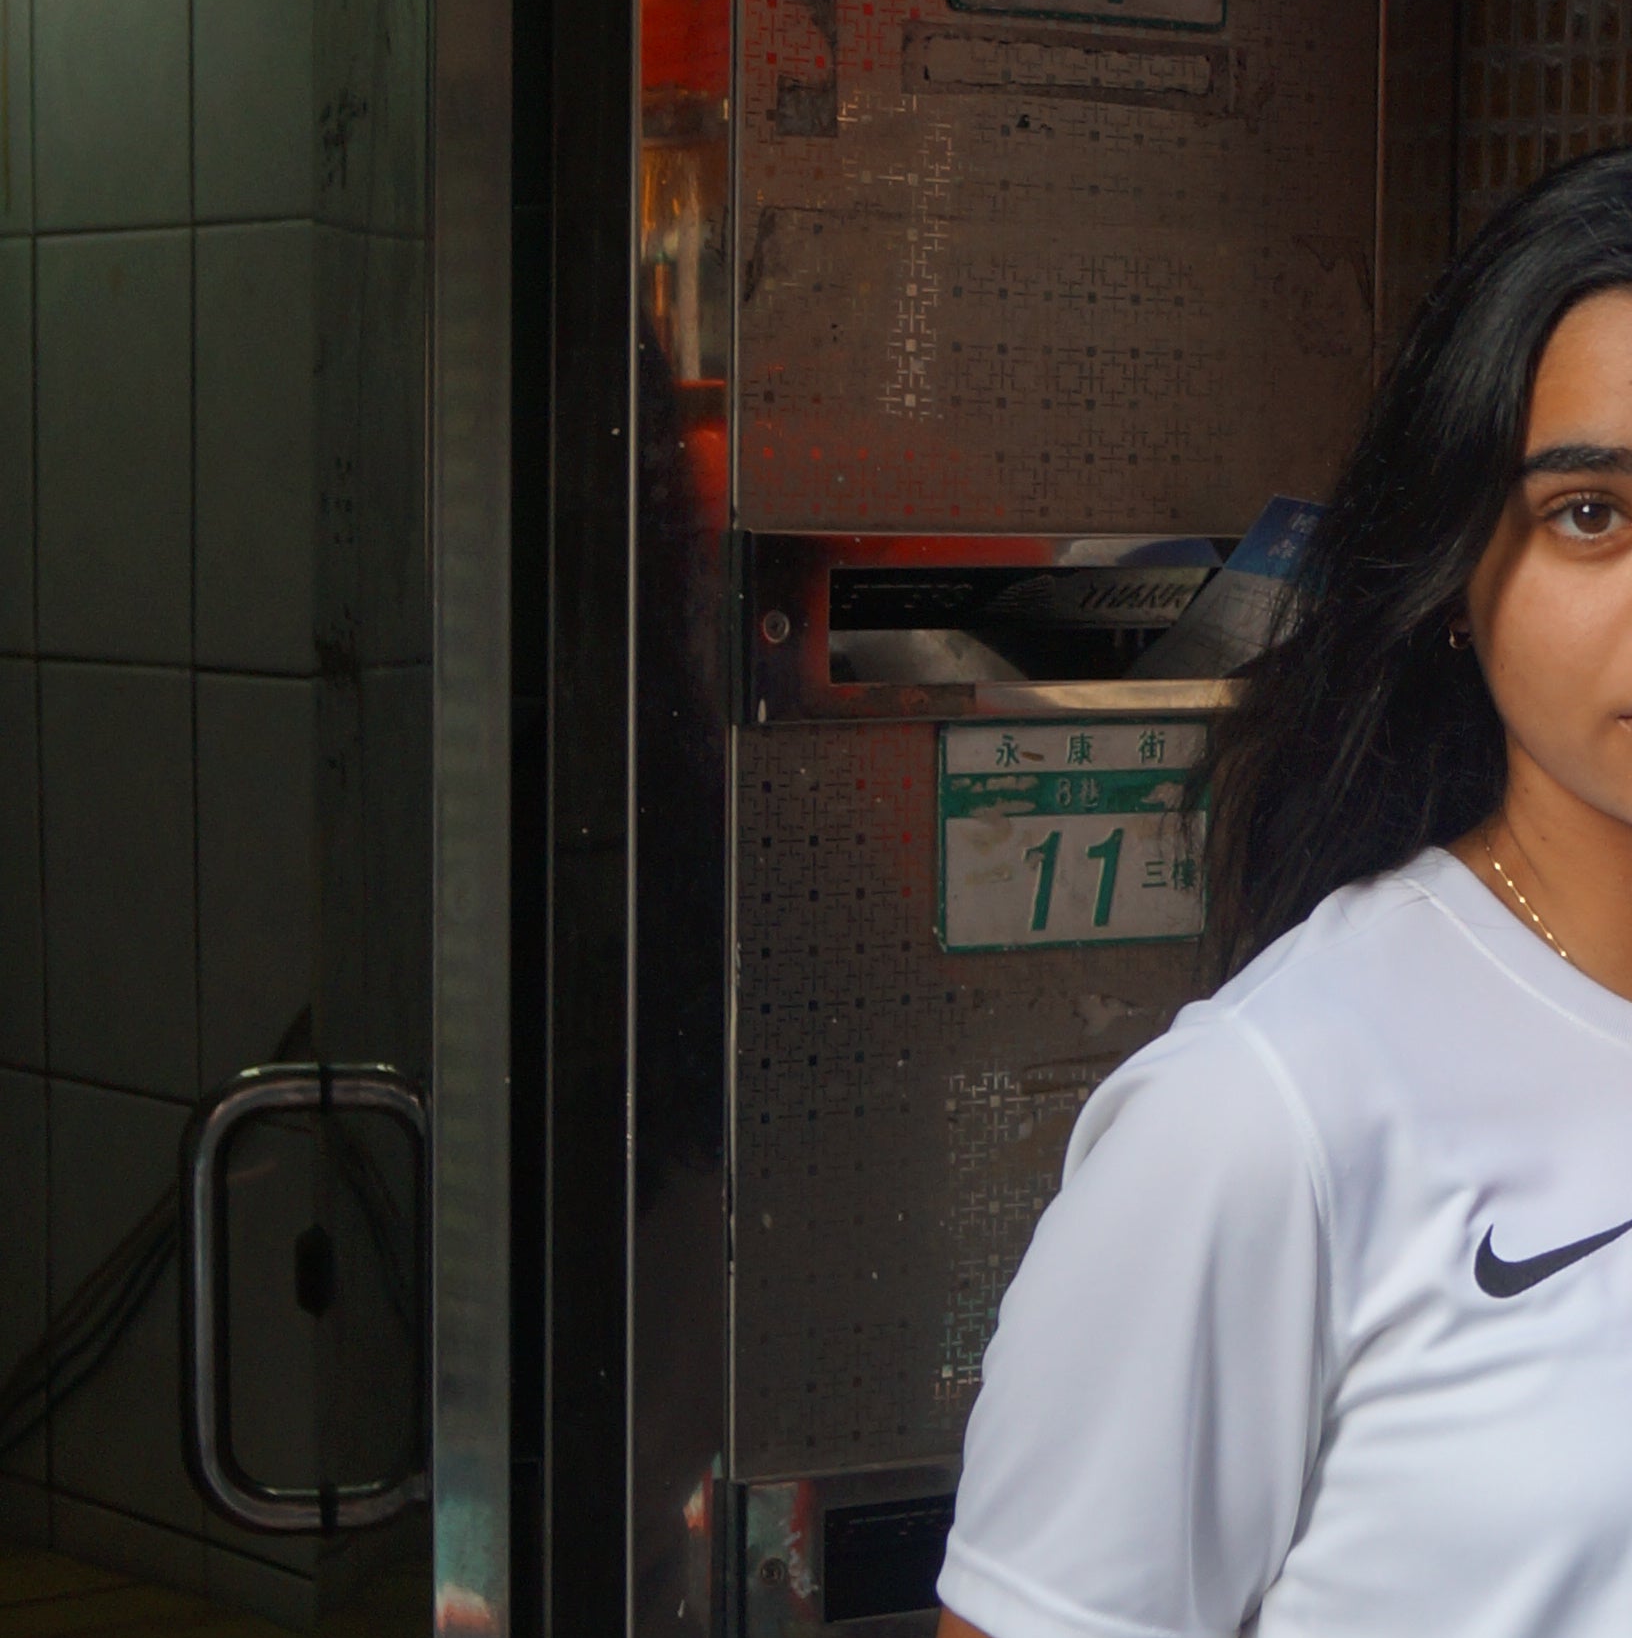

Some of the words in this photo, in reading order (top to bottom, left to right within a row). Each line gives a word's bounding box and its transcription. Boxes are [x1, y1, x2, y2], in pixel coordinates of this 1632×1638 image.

[995, 730, 1167, 768] 永康街
[1022, 828, 1124, 932] 11
